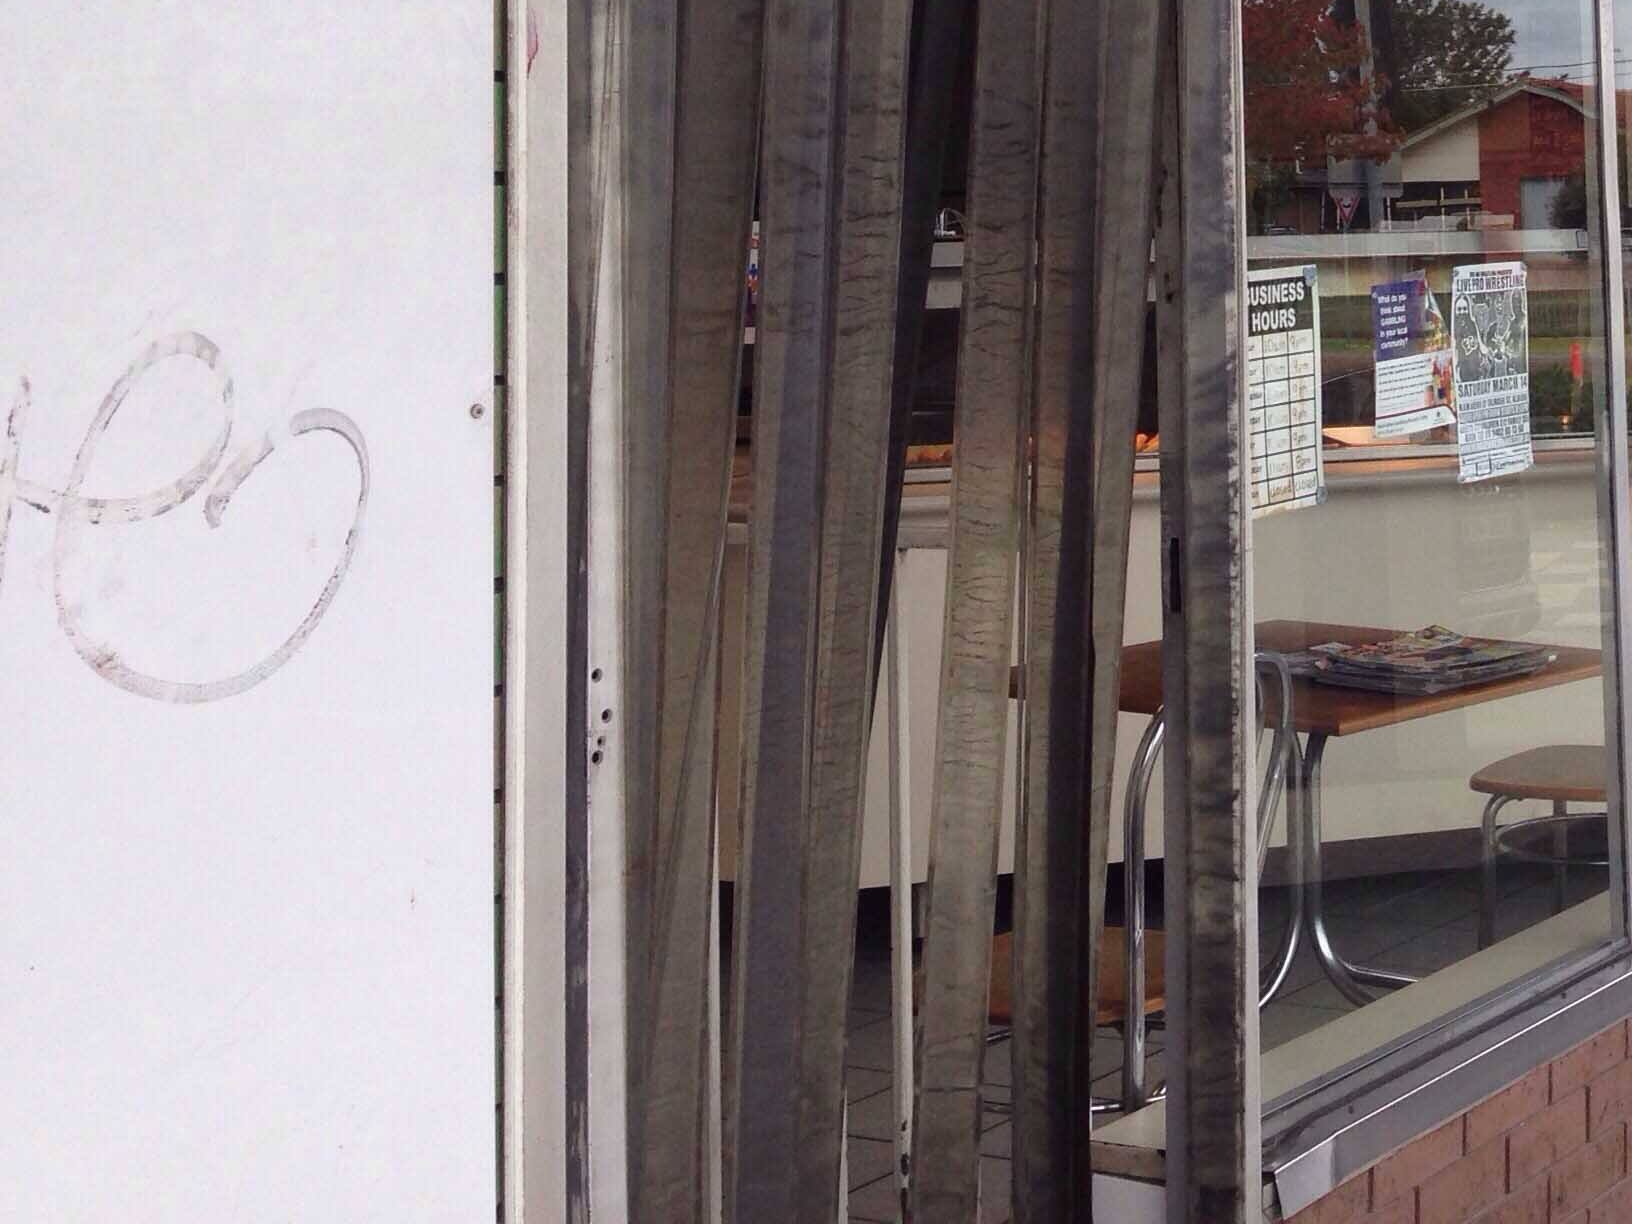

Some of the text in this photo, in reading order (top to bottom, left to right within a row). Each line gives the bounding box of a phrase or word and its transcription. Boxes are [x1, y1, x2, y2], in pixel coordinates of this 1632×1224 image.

[1252, 307, 1296, 332] HOURS
[1458, 381, 1491, 397] SATURDAY
[1492, 376, 1518, 392] MARCH
